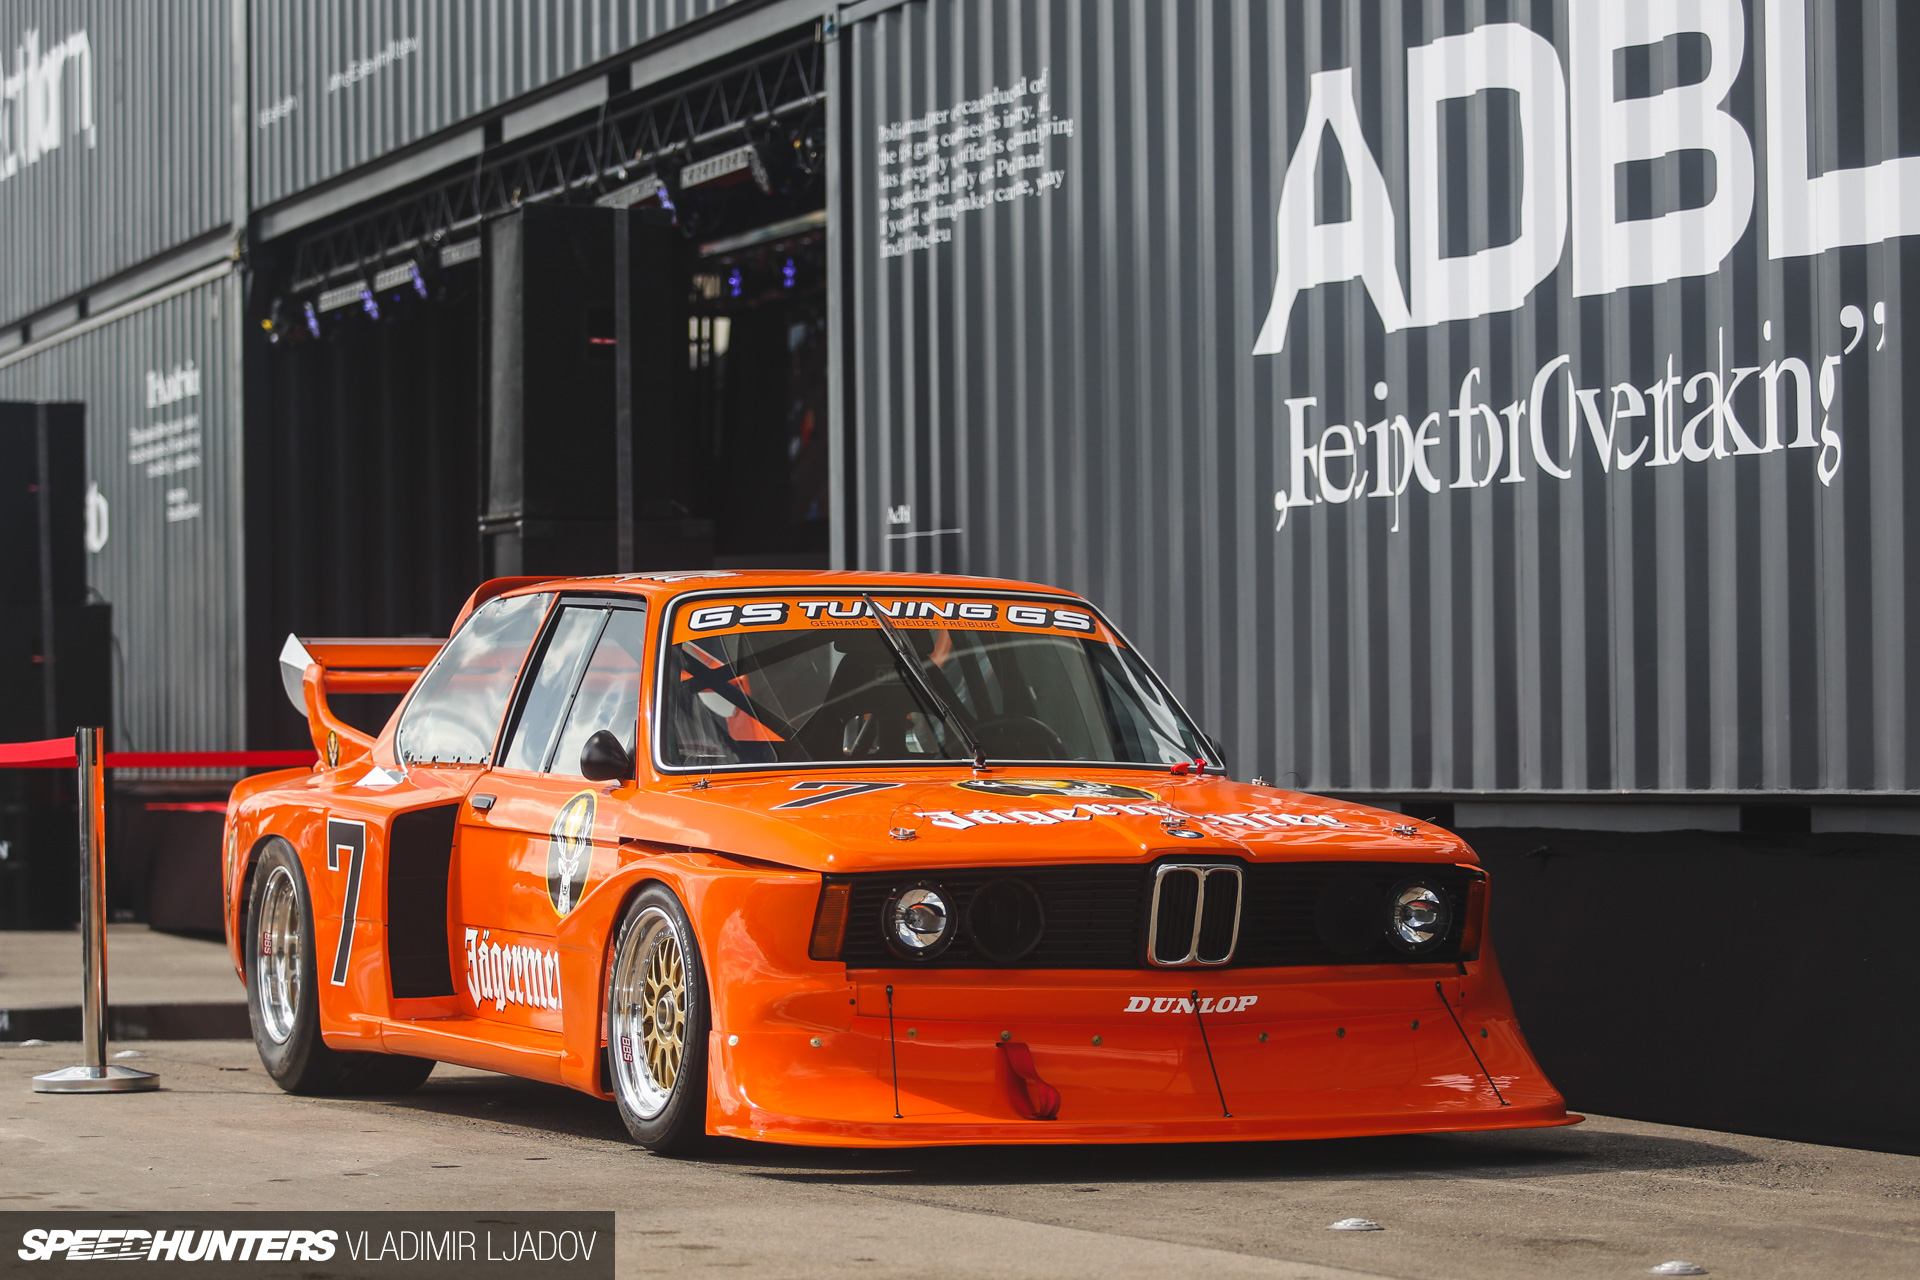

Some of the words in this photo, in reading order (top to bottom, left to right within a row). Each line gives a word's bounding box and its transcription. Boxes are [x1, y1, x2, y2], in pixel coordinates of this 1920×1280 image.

[688, 602, 790, 632] GS
[798, 600, 999, 622] TUNING
[1006, 605, 1096, 634] GS
[810, 619, 869, 628] GERHARD
[872, 619, 941, 628] SHNEIDER
[942, 619, 1001, 629] FREIBURG
[327, 816, 367, 987] 7
[1123, 995, 1259, 1014] DUNLOP
[621, 1036, 634, 1063] BBS
